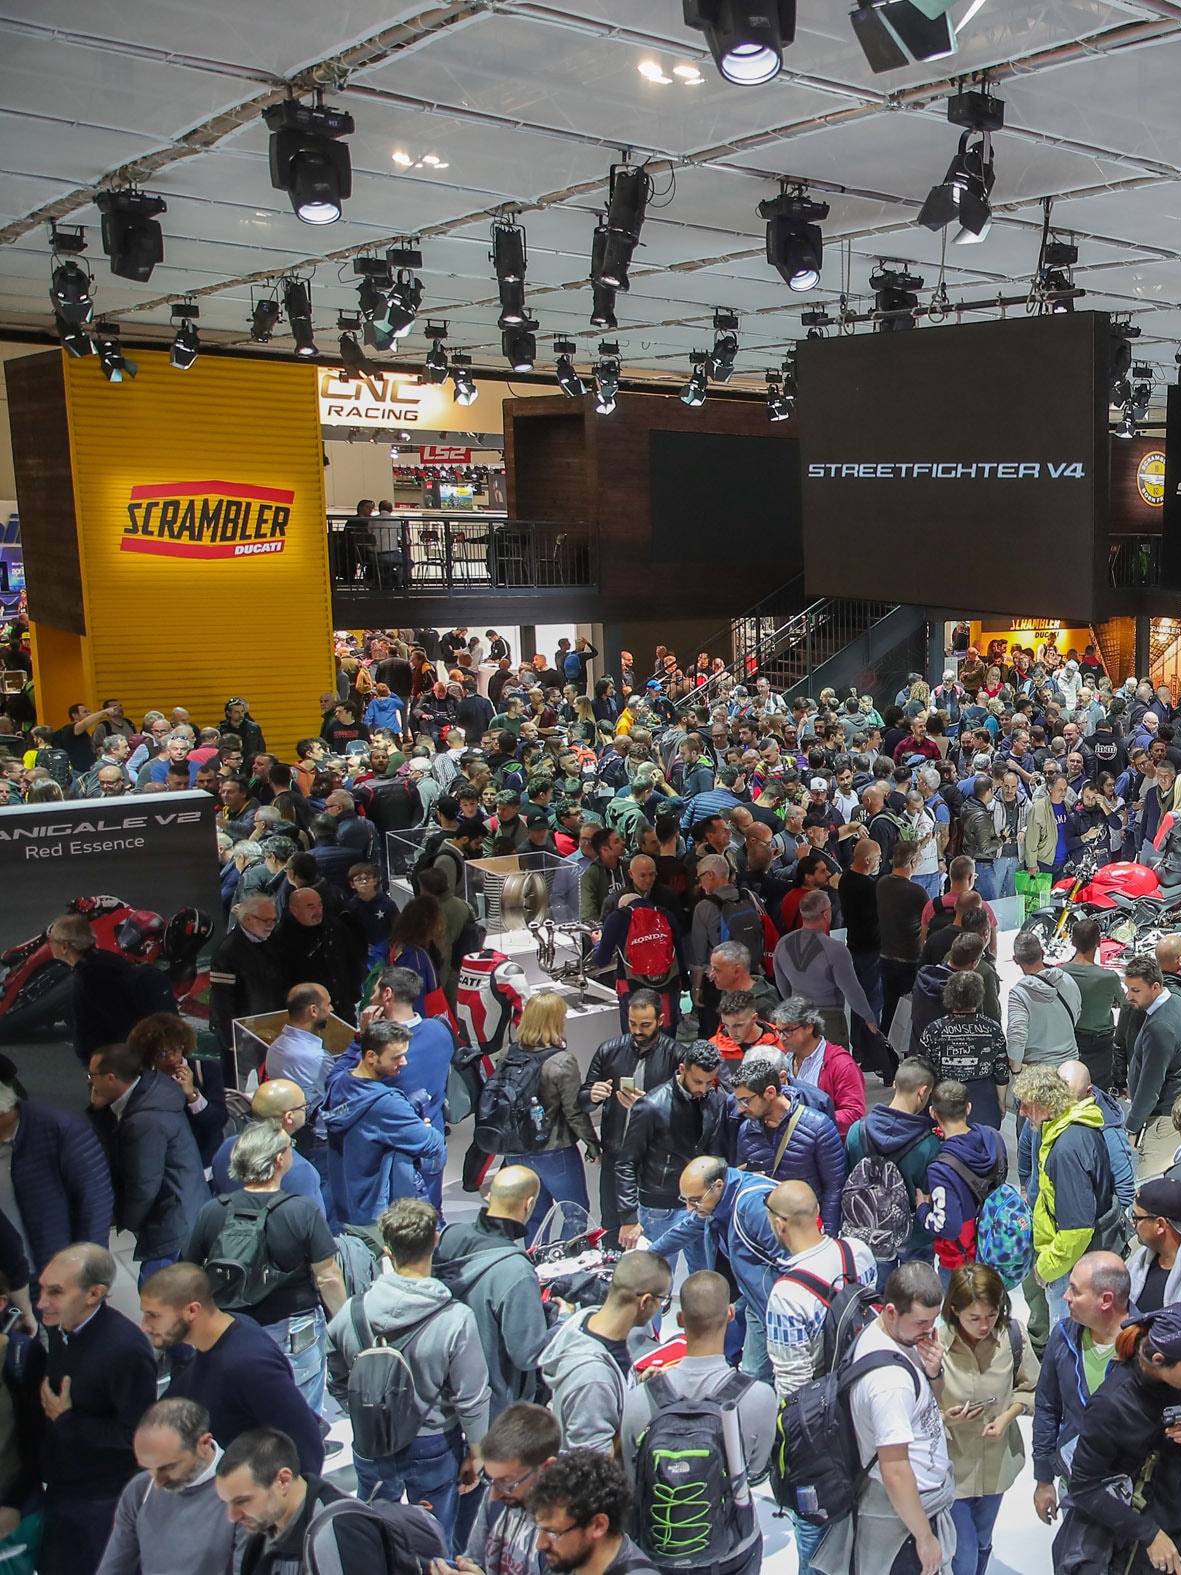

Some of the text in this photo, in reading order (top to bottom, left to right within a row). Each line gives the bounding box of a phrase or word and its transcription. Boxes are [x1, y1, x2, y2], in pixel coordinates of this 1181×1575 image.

[320, 374, 421, 404] CNC
[327, 405, 419, 421] RACING
[423, 446, 467, 460] LS2
[807, 463, 1086, 479] STREETFIGHTER V4
[123, 498, 291, 543] SCRAMBLER
[234, 541, 282, 556] DUCATI
[1150, 625, 1181, 635] RAMBLER
[0, 811, 202, 841] ANIGALE V2
[25, 836, 146, 860] Red Essence
[630, 932, 669, 946] HONDA
[459, 974, 482, 988] CATI
